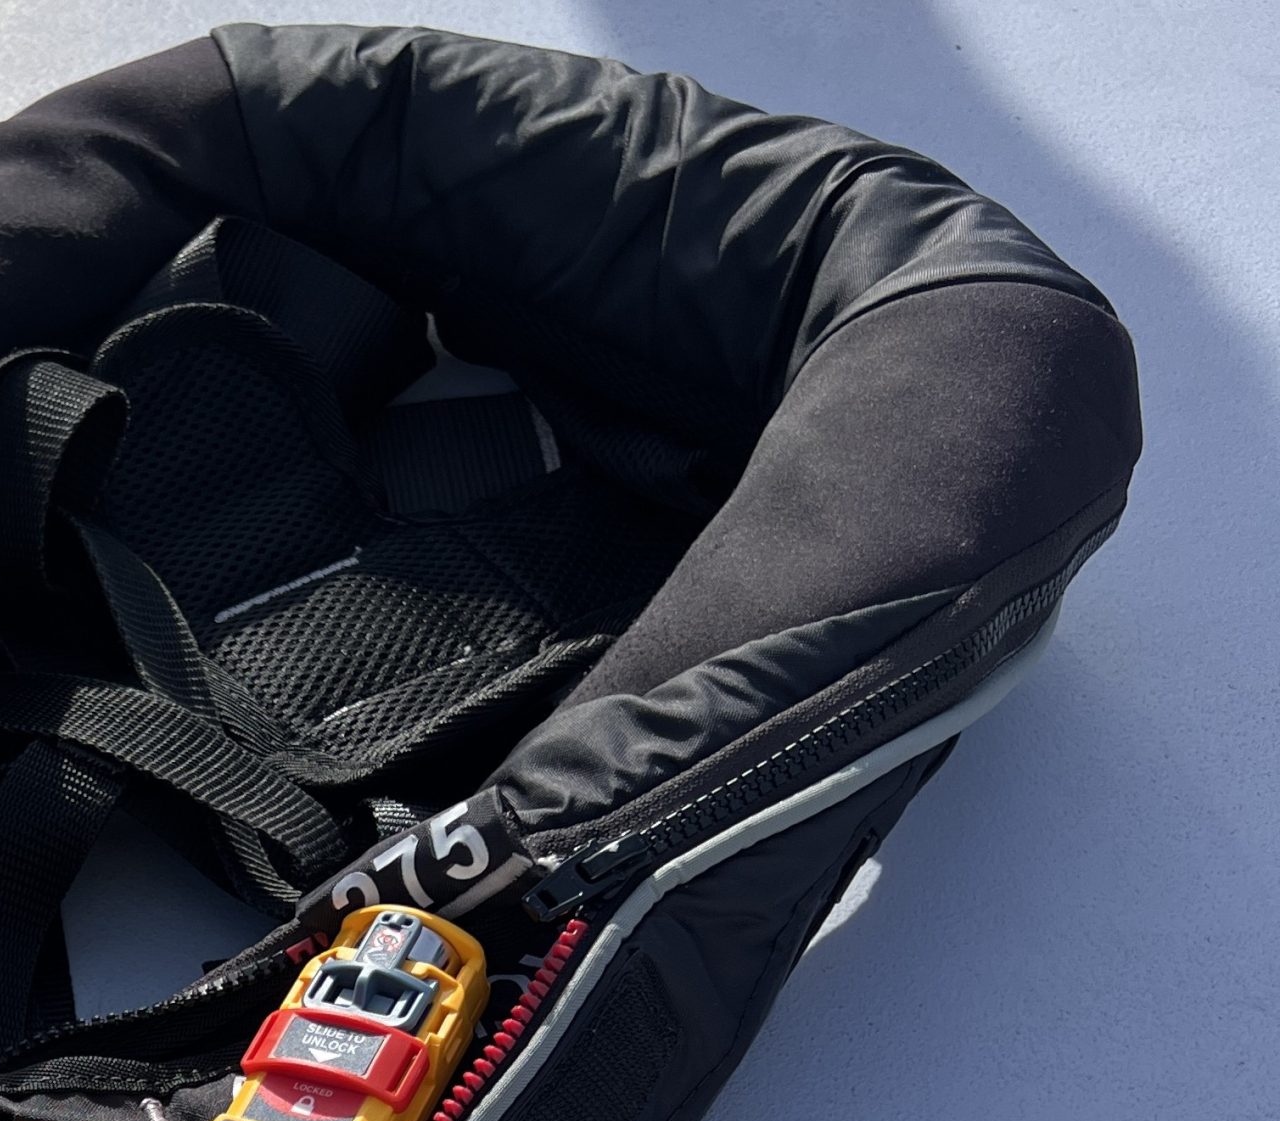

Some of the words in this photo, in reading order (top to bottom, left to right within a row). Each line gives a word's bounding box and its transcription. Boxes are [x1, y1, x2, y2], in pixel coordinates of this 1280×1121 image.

[306, 1023, 347, 1040] SLIDE
[347, 1031, 366, 1043] TO
[302, 1034, 360, 1055] UNLOCK
[293, 1082, 333, 1097] LOCKED
